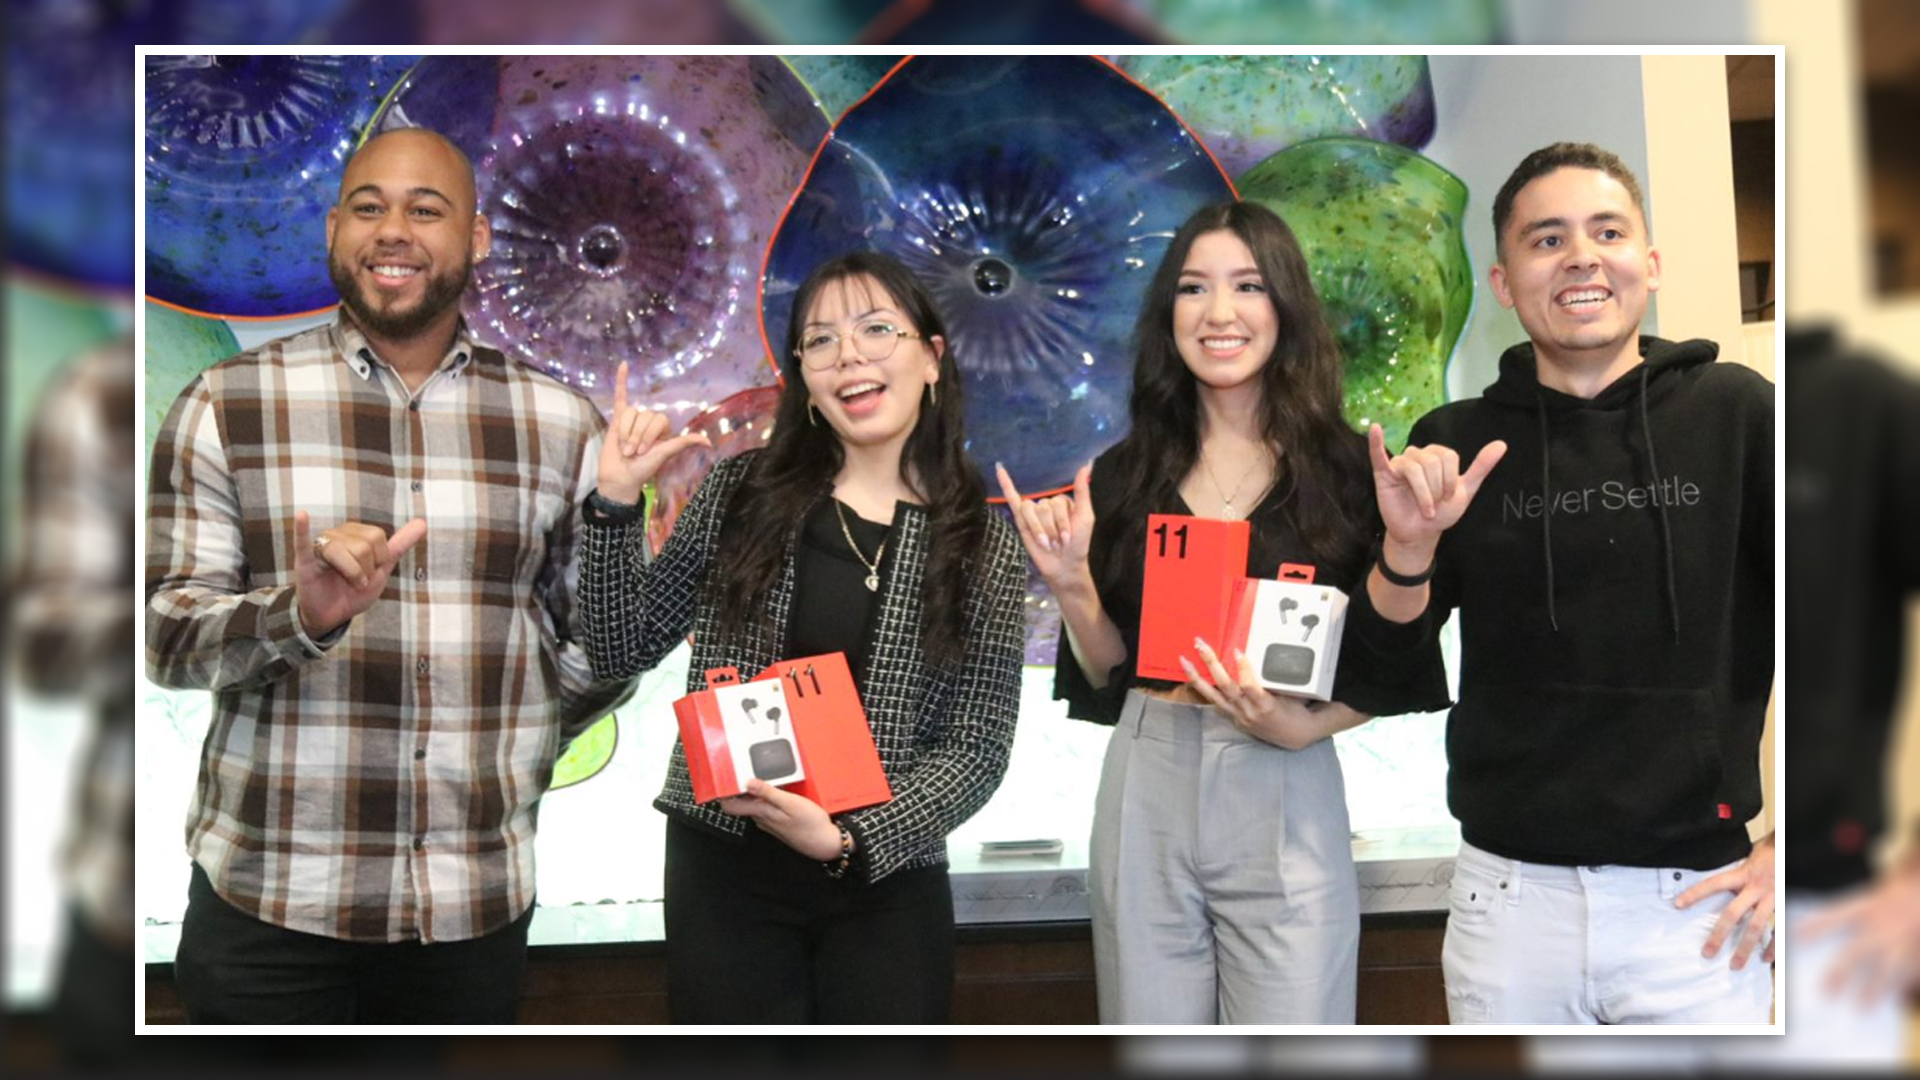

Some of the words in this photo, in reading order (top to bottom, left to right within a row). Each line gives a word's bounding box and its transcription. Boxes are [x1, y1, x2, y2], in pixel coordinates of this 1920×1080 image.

[1601, 475, 1700, 509] Settle
[1153, 522, 1188, 559] 11
[786, 663, 821, 698] 11
